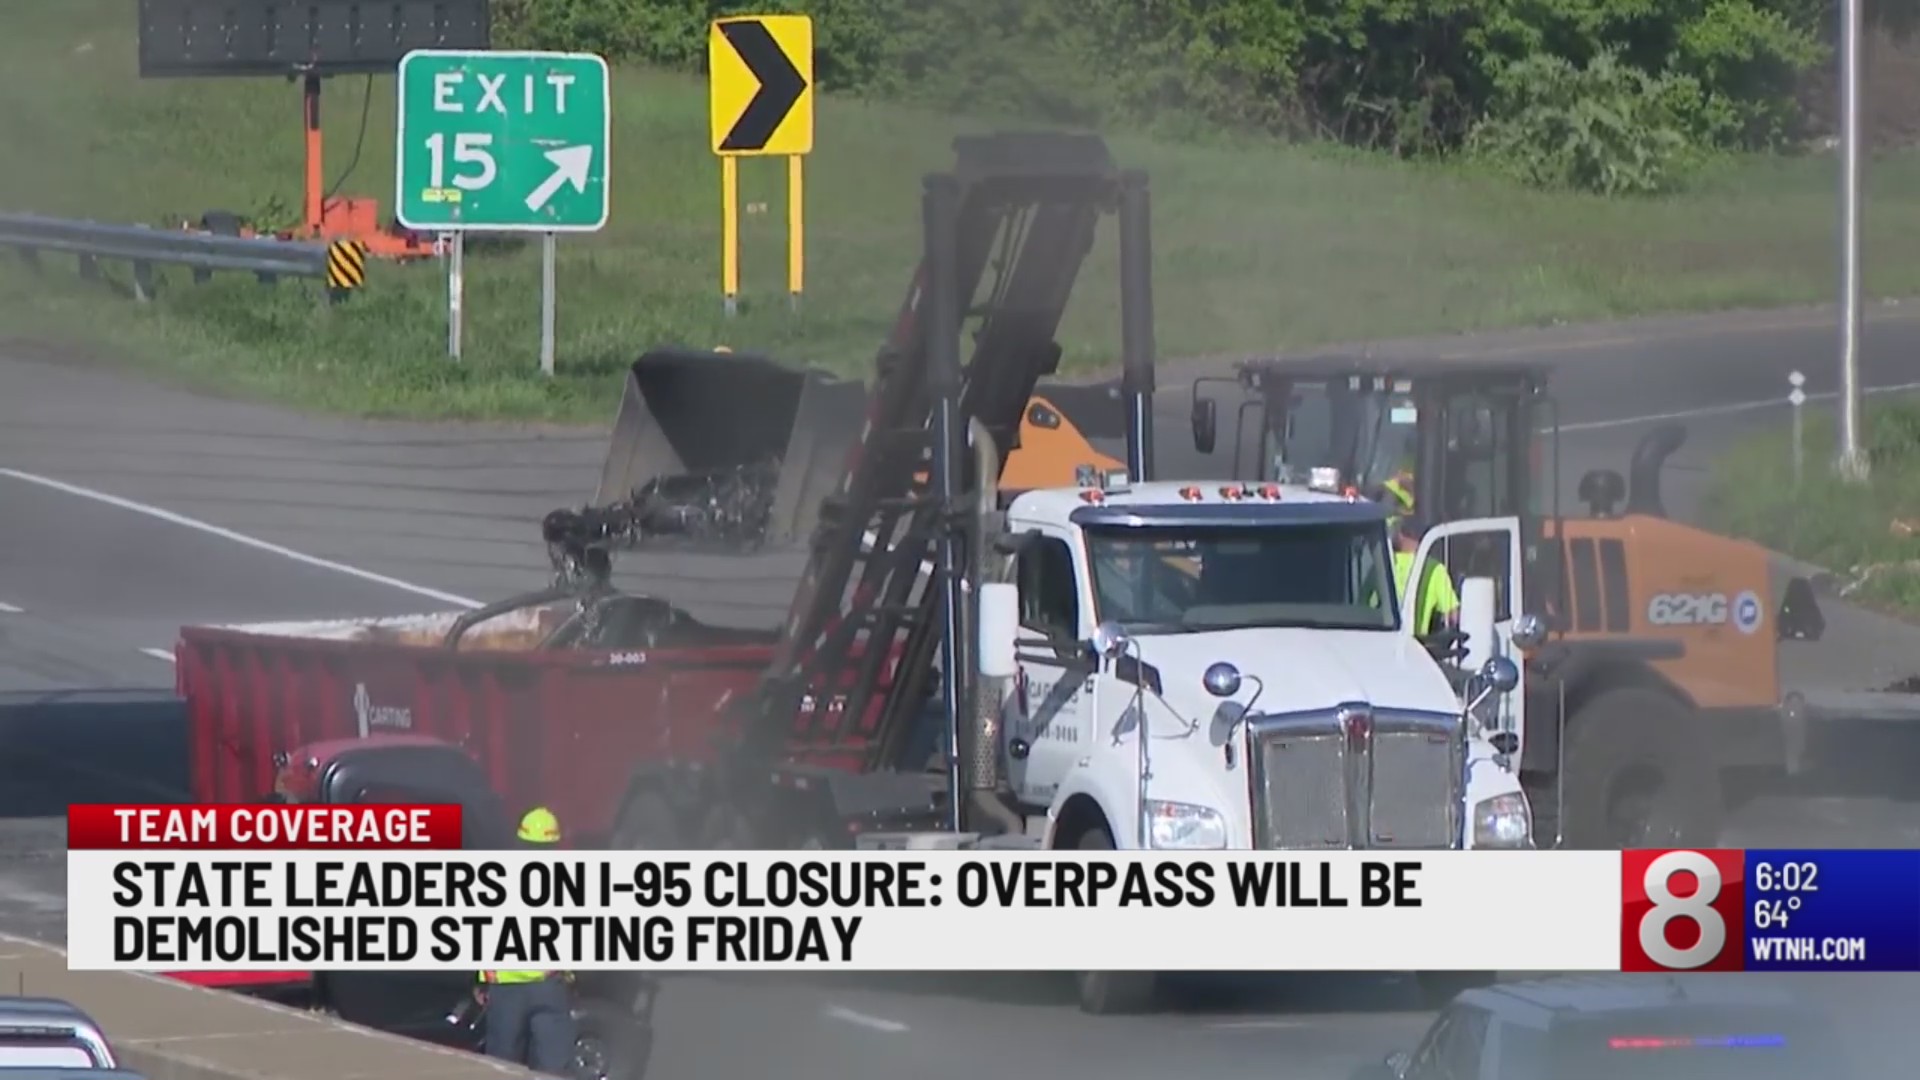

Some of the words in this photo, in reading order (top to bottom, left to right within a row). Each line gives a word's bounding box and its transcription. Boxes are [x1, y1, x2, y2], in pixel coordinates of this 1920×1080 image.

[434, 73, 576, 114] EXIT
[425, 132, 496, 190] 15
[1648, 593, 1727, 624] 621G
